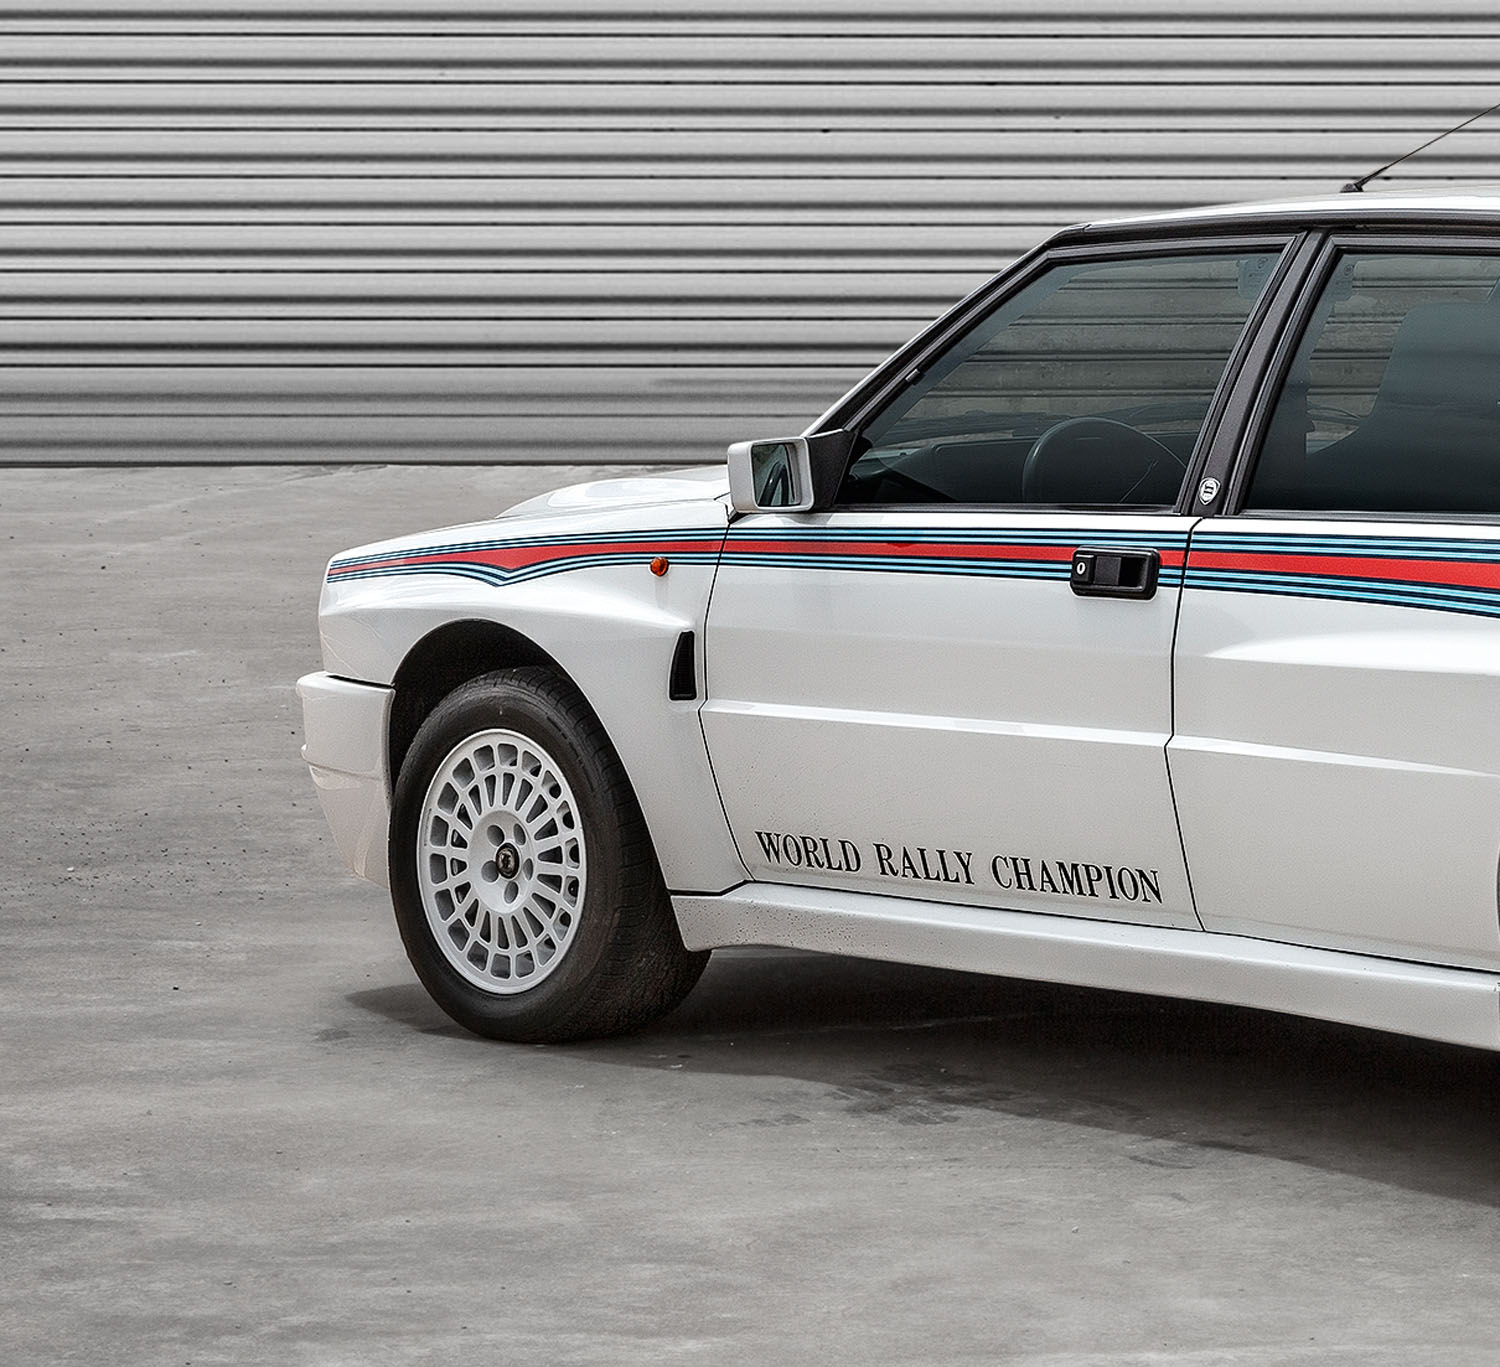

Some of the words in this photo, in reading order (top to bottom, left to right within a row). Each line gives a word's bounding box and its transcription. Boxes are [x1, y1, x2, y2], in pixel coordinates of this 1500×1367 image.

[755, 831, 862, 873] WORLD
[873, 843, 976, 885] RALLY
[991, 855, 1164, 904] CHAMPION
